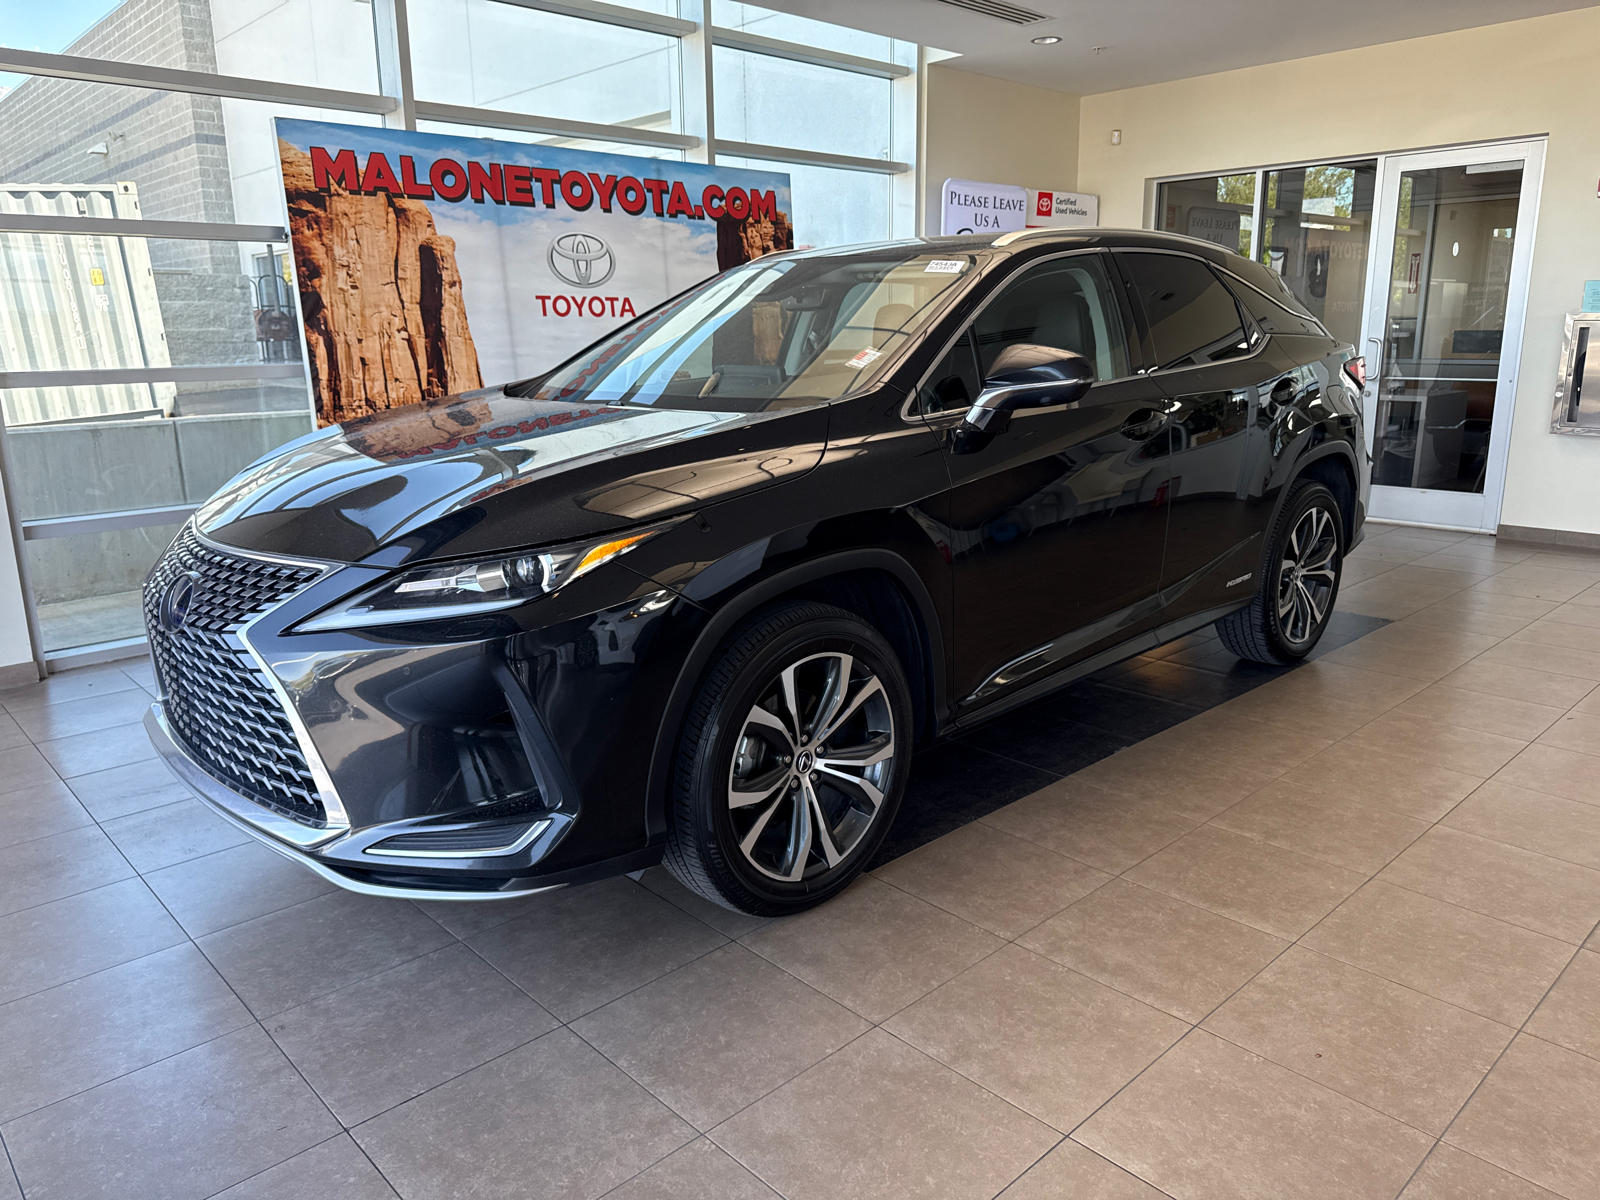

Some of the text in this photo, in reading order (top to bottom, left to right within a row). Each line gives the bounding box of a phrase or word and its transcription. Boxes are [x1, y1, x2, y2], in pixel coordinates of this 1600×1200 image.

[310, 146, 778, 224] MALONETOYOTA.COM
[950, 191, 1025, 212] PLEASE LEAVE
[1055, 197, 1077, 206] Certified
[1055, 207, 1088, 217] Used Vehicles
[992, 216, 1000, 228] A
[535, 295, 637, 318] TOYOTA
